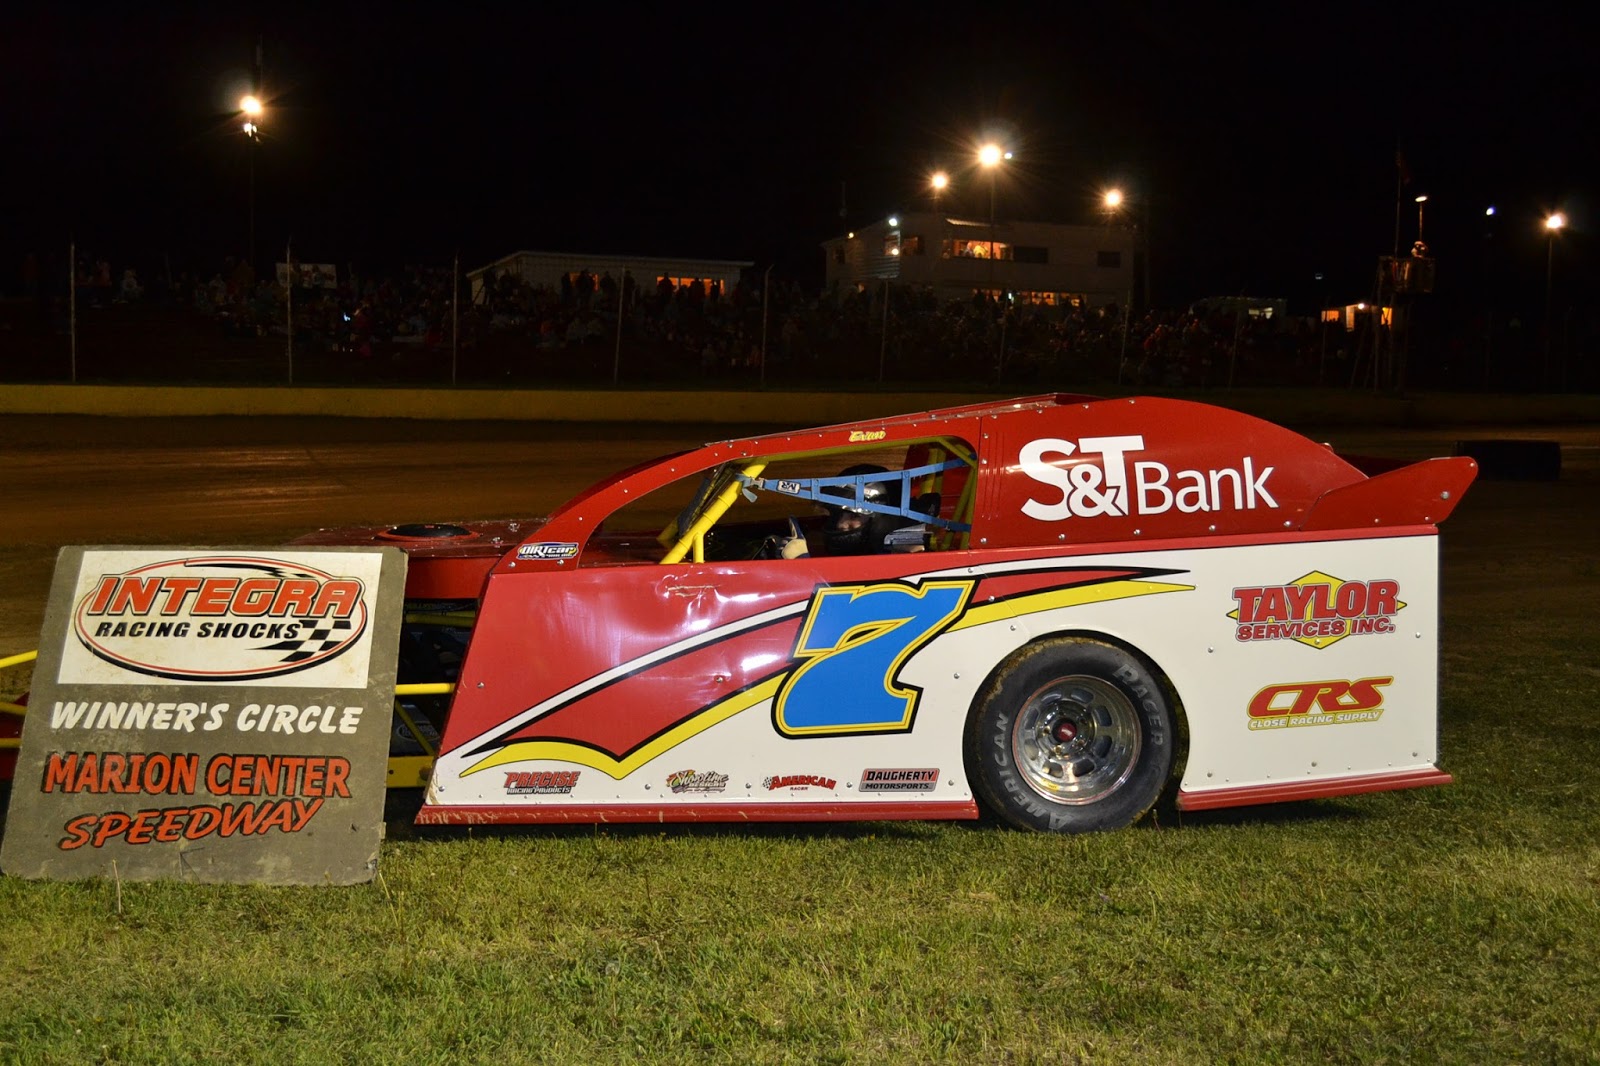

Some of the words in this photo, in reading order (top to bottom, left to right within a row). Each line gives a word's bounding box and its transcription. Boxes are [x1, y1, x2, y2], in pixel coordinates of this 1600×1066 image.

[1019, 435, 1145, 522] S&T
[1134, 457, 1280, 516] Bank
[87, 576, 361, 619] INTEGRA
[1232, 579, 1401, 624] TAYLOR
[95, 621, 191, 638] RACING
[197, 622, 301, 639] SHOCKS
[1236, 619, 1346, 642] SERVICES
[1350, 616, 1397, 635] INC.
[771, 577, 981, 739] 7
[1112, 663, 1164, 747] RACER
[1246, 676, 1394, 718] CRS
[50, 702, 229, 733] WINNER'S
[236, 703, 364, 735] CIRCLE
[1250, 718, 1287, 729] CLOSE
[1289, 714, 1334, 726] RACING
[1336, 710, 1381, 723] SUPPLY
[41, 752, 200, 795] MARION
[205, 753, 352, 799] CENTER
[504, 771, 581, 788] PRECISE
[768, 775, 837, 791] AMERICAN
[866, 771, 935, 781] DAUGHERTY
[994, 713, 1075, 830] AMERICAN
[58, 797, 325, 850] SPEEDWAY
